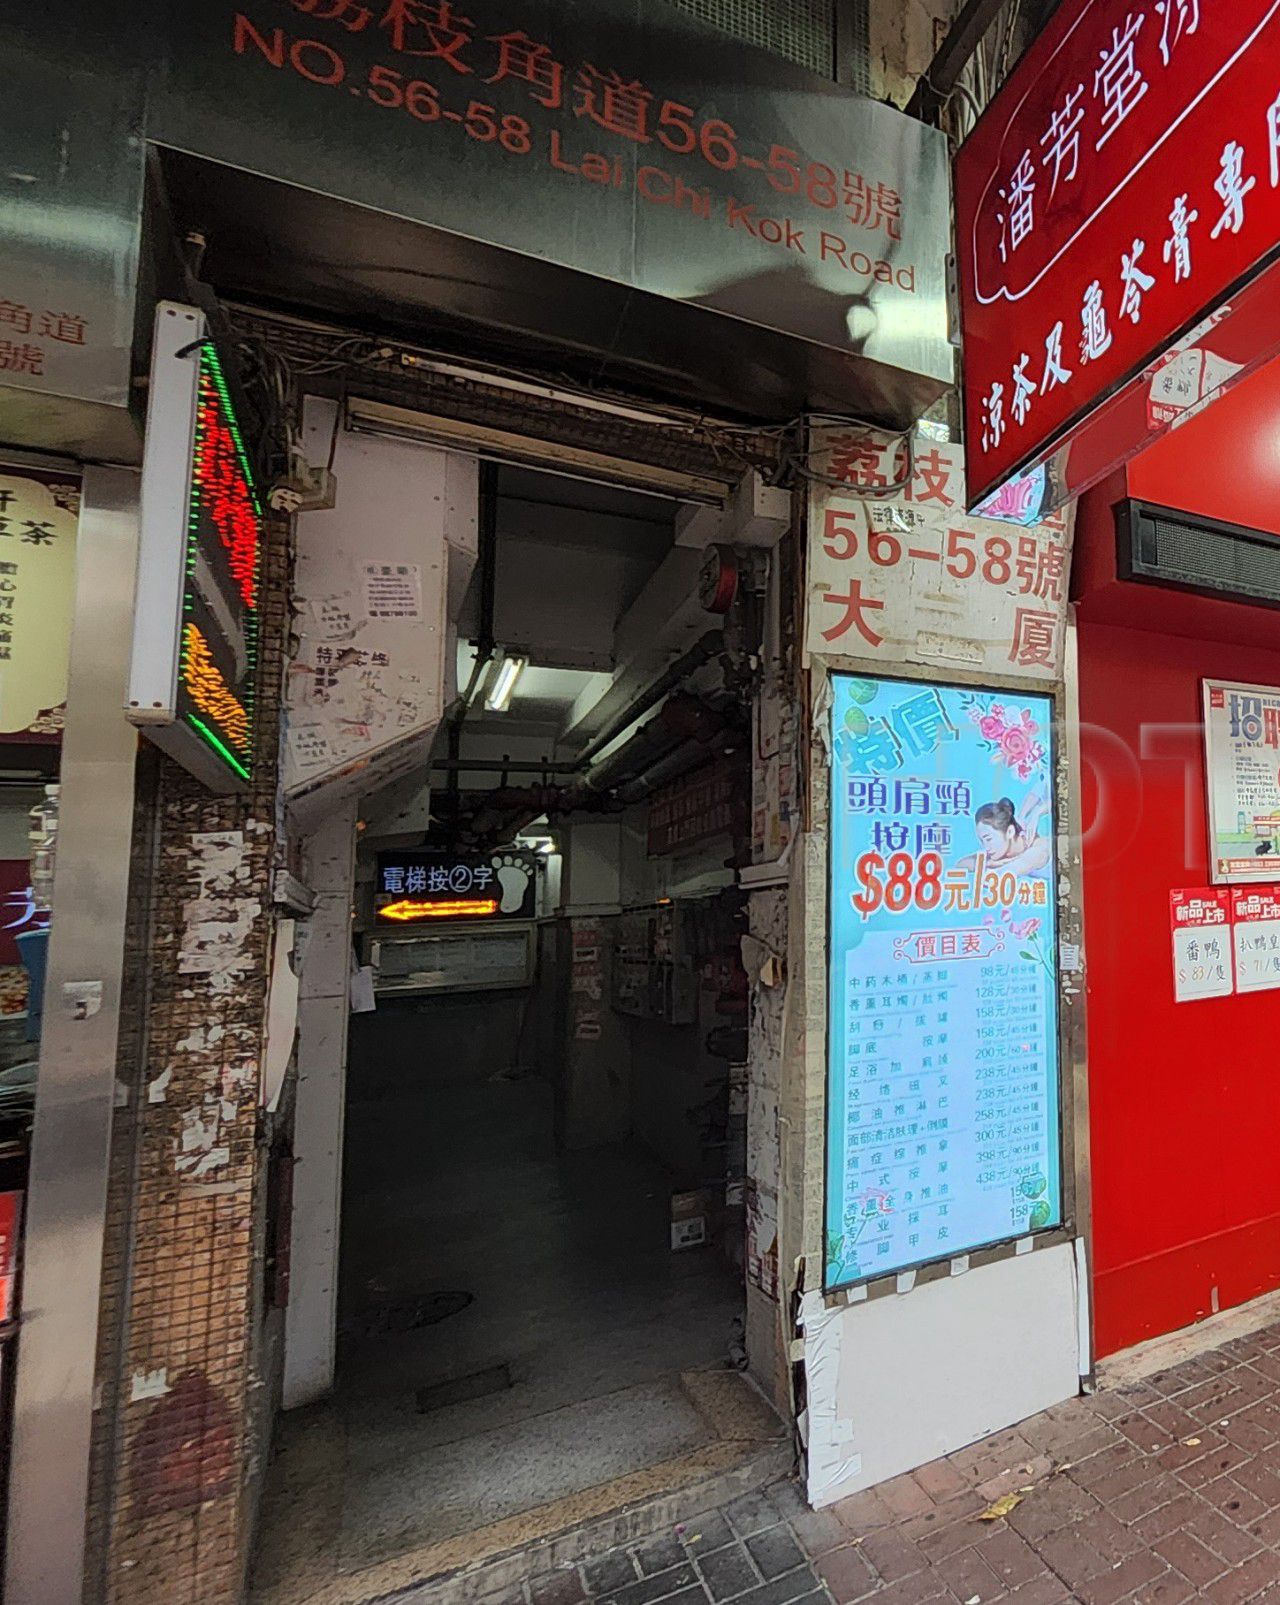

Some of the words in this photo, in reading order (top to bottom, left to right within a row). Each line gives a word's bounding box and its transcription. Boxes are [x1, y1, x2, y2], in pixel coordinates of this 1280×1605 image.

[550, 129, 623, 189] Lai
[638, 165, 712, 220] Chi
[728, 198, 806, 255] Kok
[819, 230, 916, 294] Road
[821, 578, 1059, 669] 大廈
[914, 935, 982, 958] 價目表
